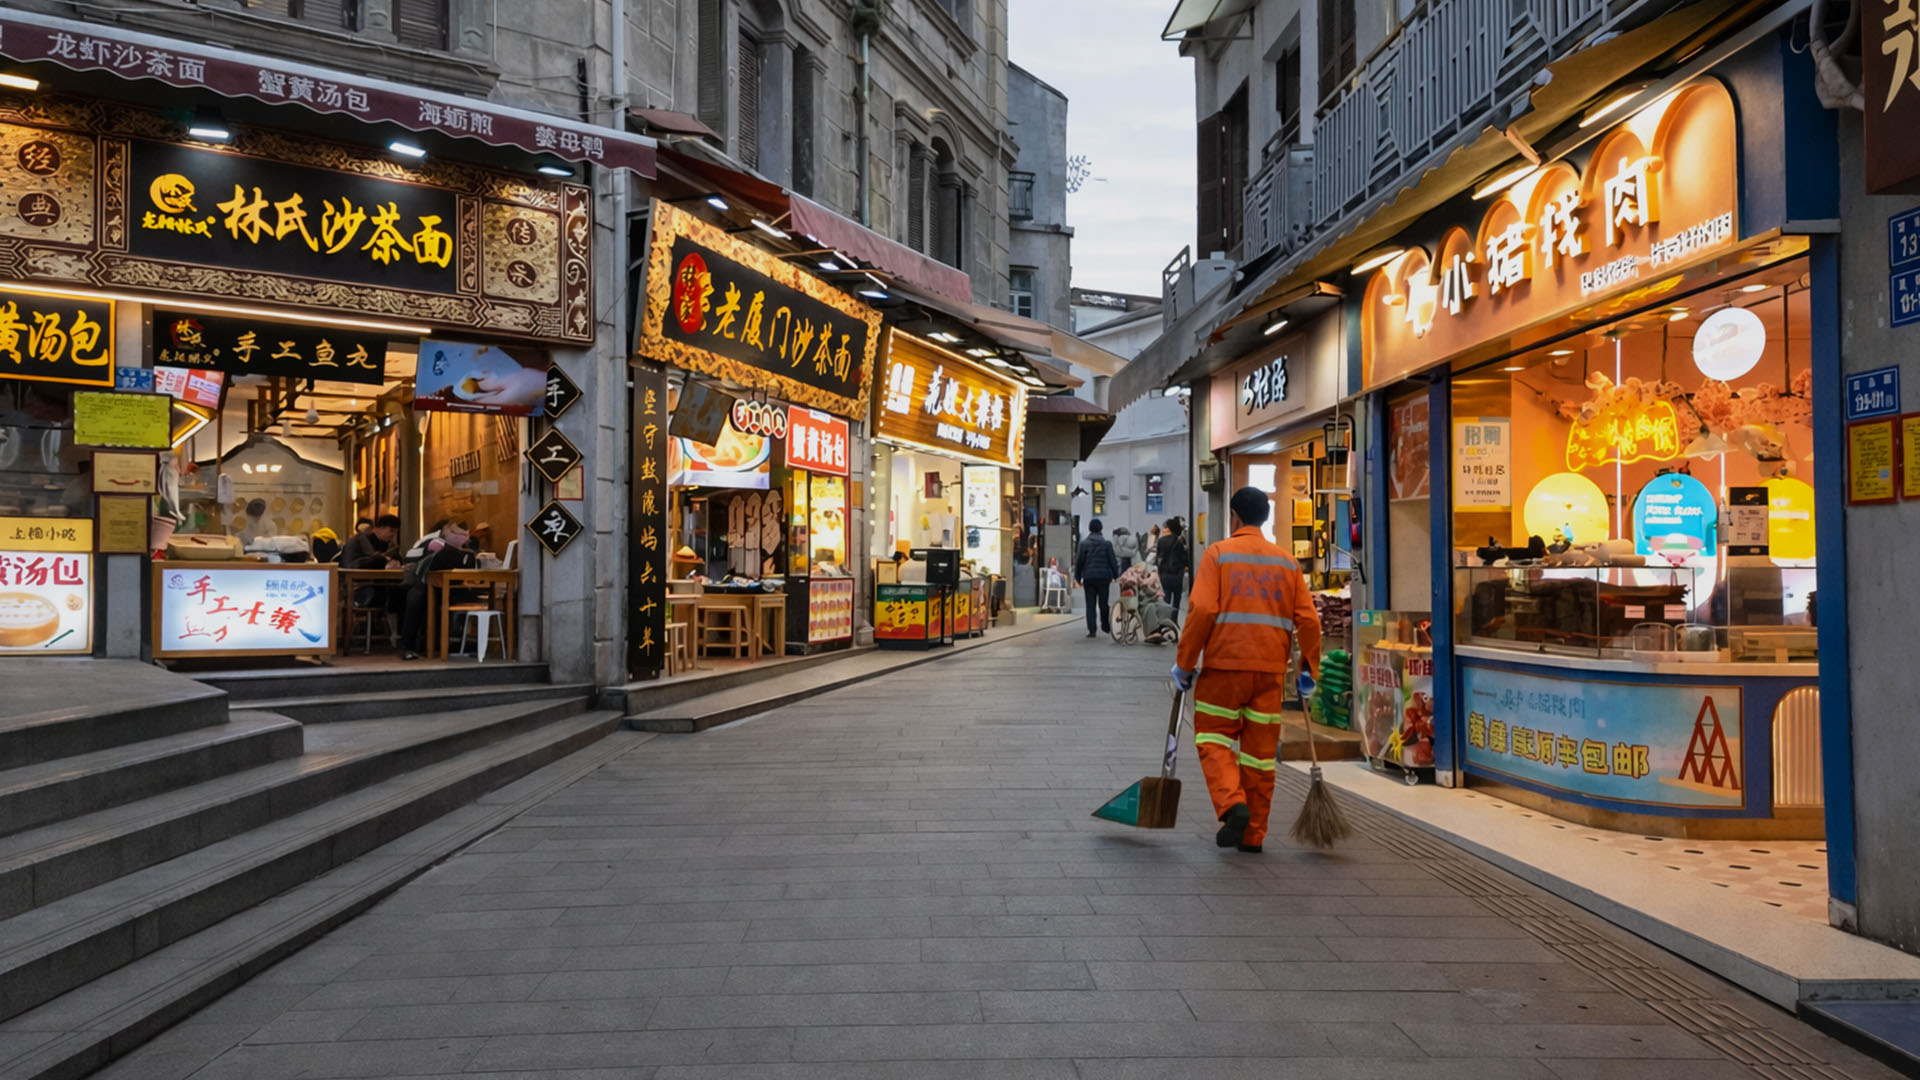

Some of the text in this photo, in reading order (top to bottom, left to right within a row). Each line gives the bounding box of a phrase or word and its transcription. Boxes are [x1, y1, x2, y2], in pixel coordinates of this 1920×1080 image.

[48, 32, 206, 83] 龙虾沙茶面
[258, 69, 371, 112] 蟹黄汤包
[216, 183, 453, 269] 林氏沙茶面
[232, 330, 378, 370] 手工鱼丸
